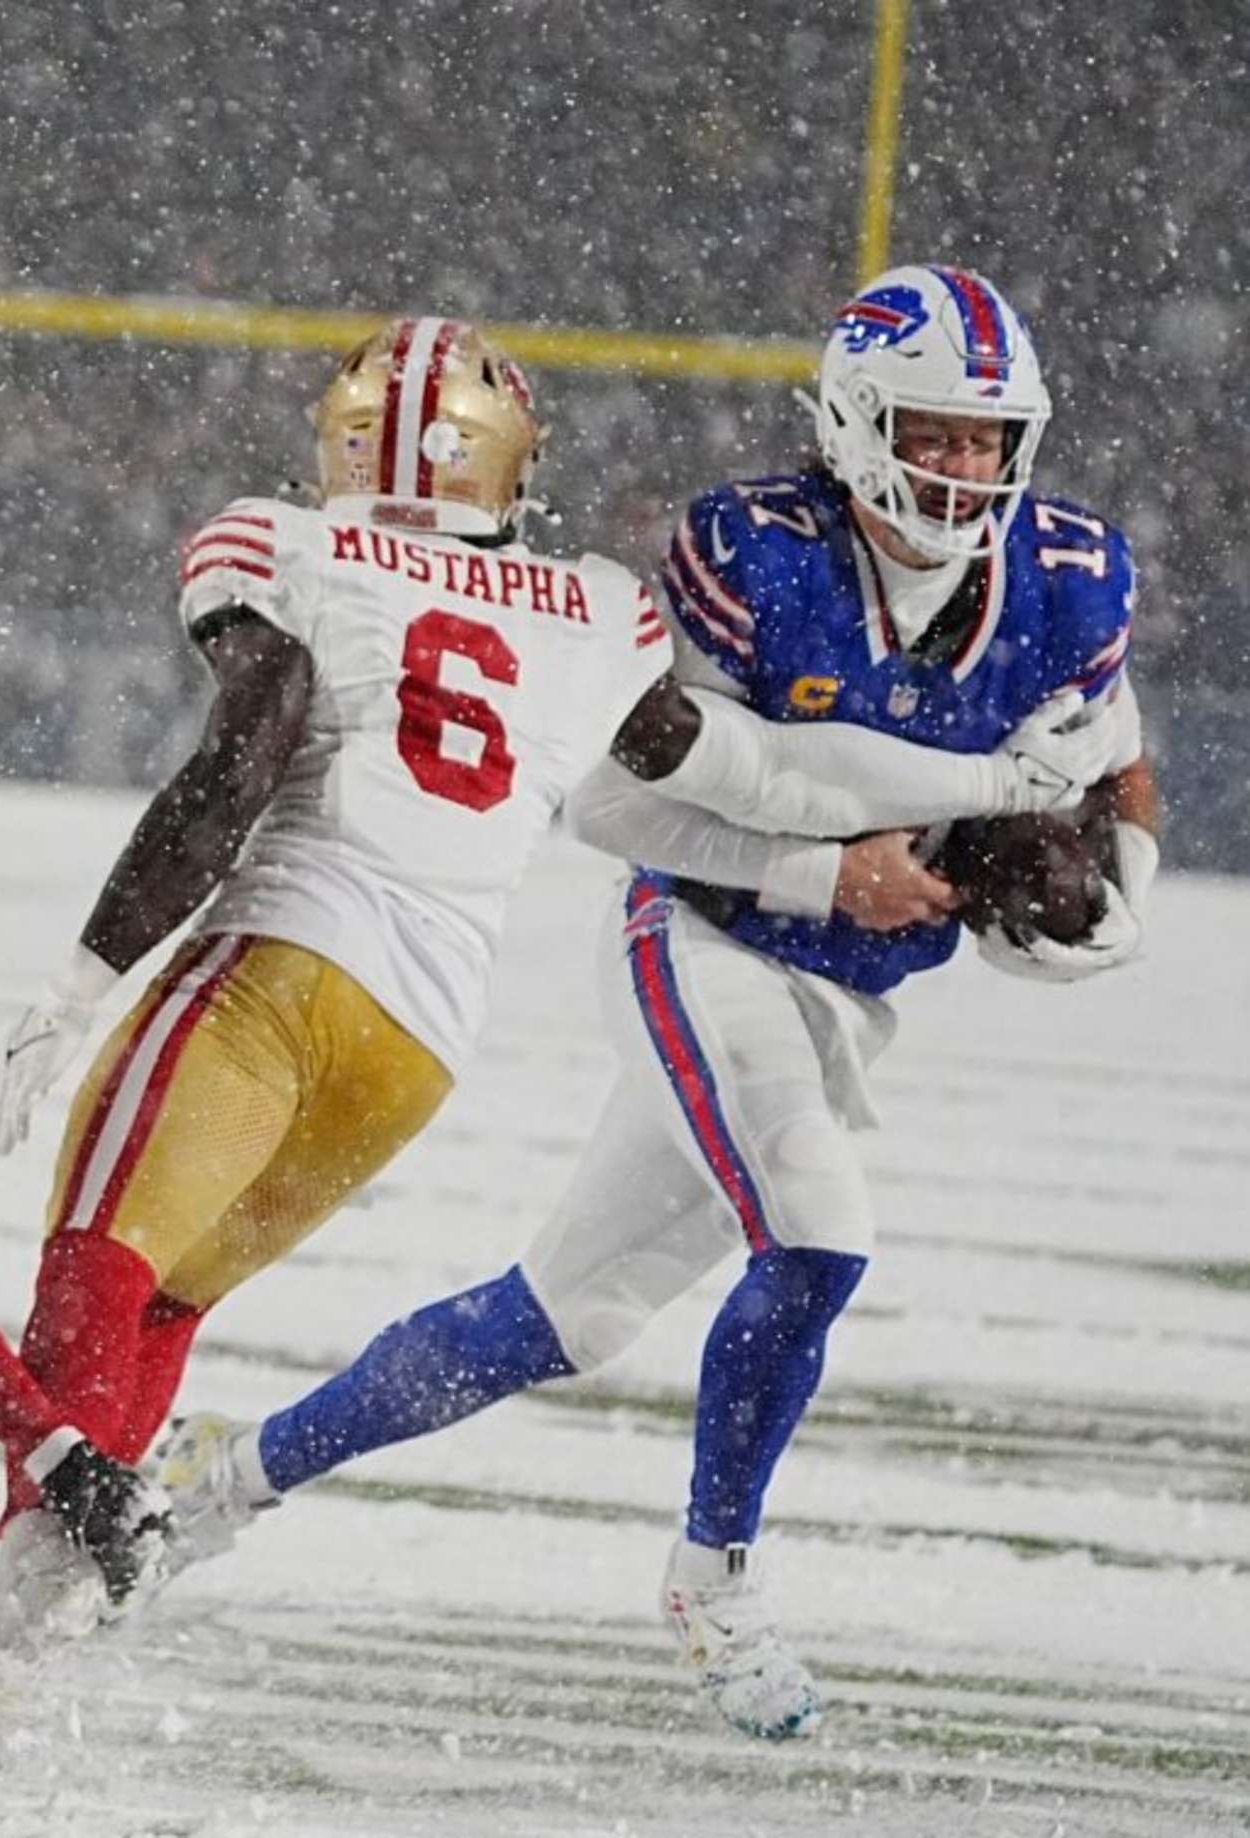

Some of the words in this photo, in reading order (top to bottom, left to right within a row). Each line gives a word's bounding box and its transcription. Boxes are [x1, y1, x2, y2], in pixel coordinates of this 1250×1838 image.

[731, 480, 821, 540] 17
[1035, 502, 1107, 579] 17
[328, 526, 591, 625] MUSTAPHA
[396, 607, 520, 814] 6
[788, 674, 840, 712] C
